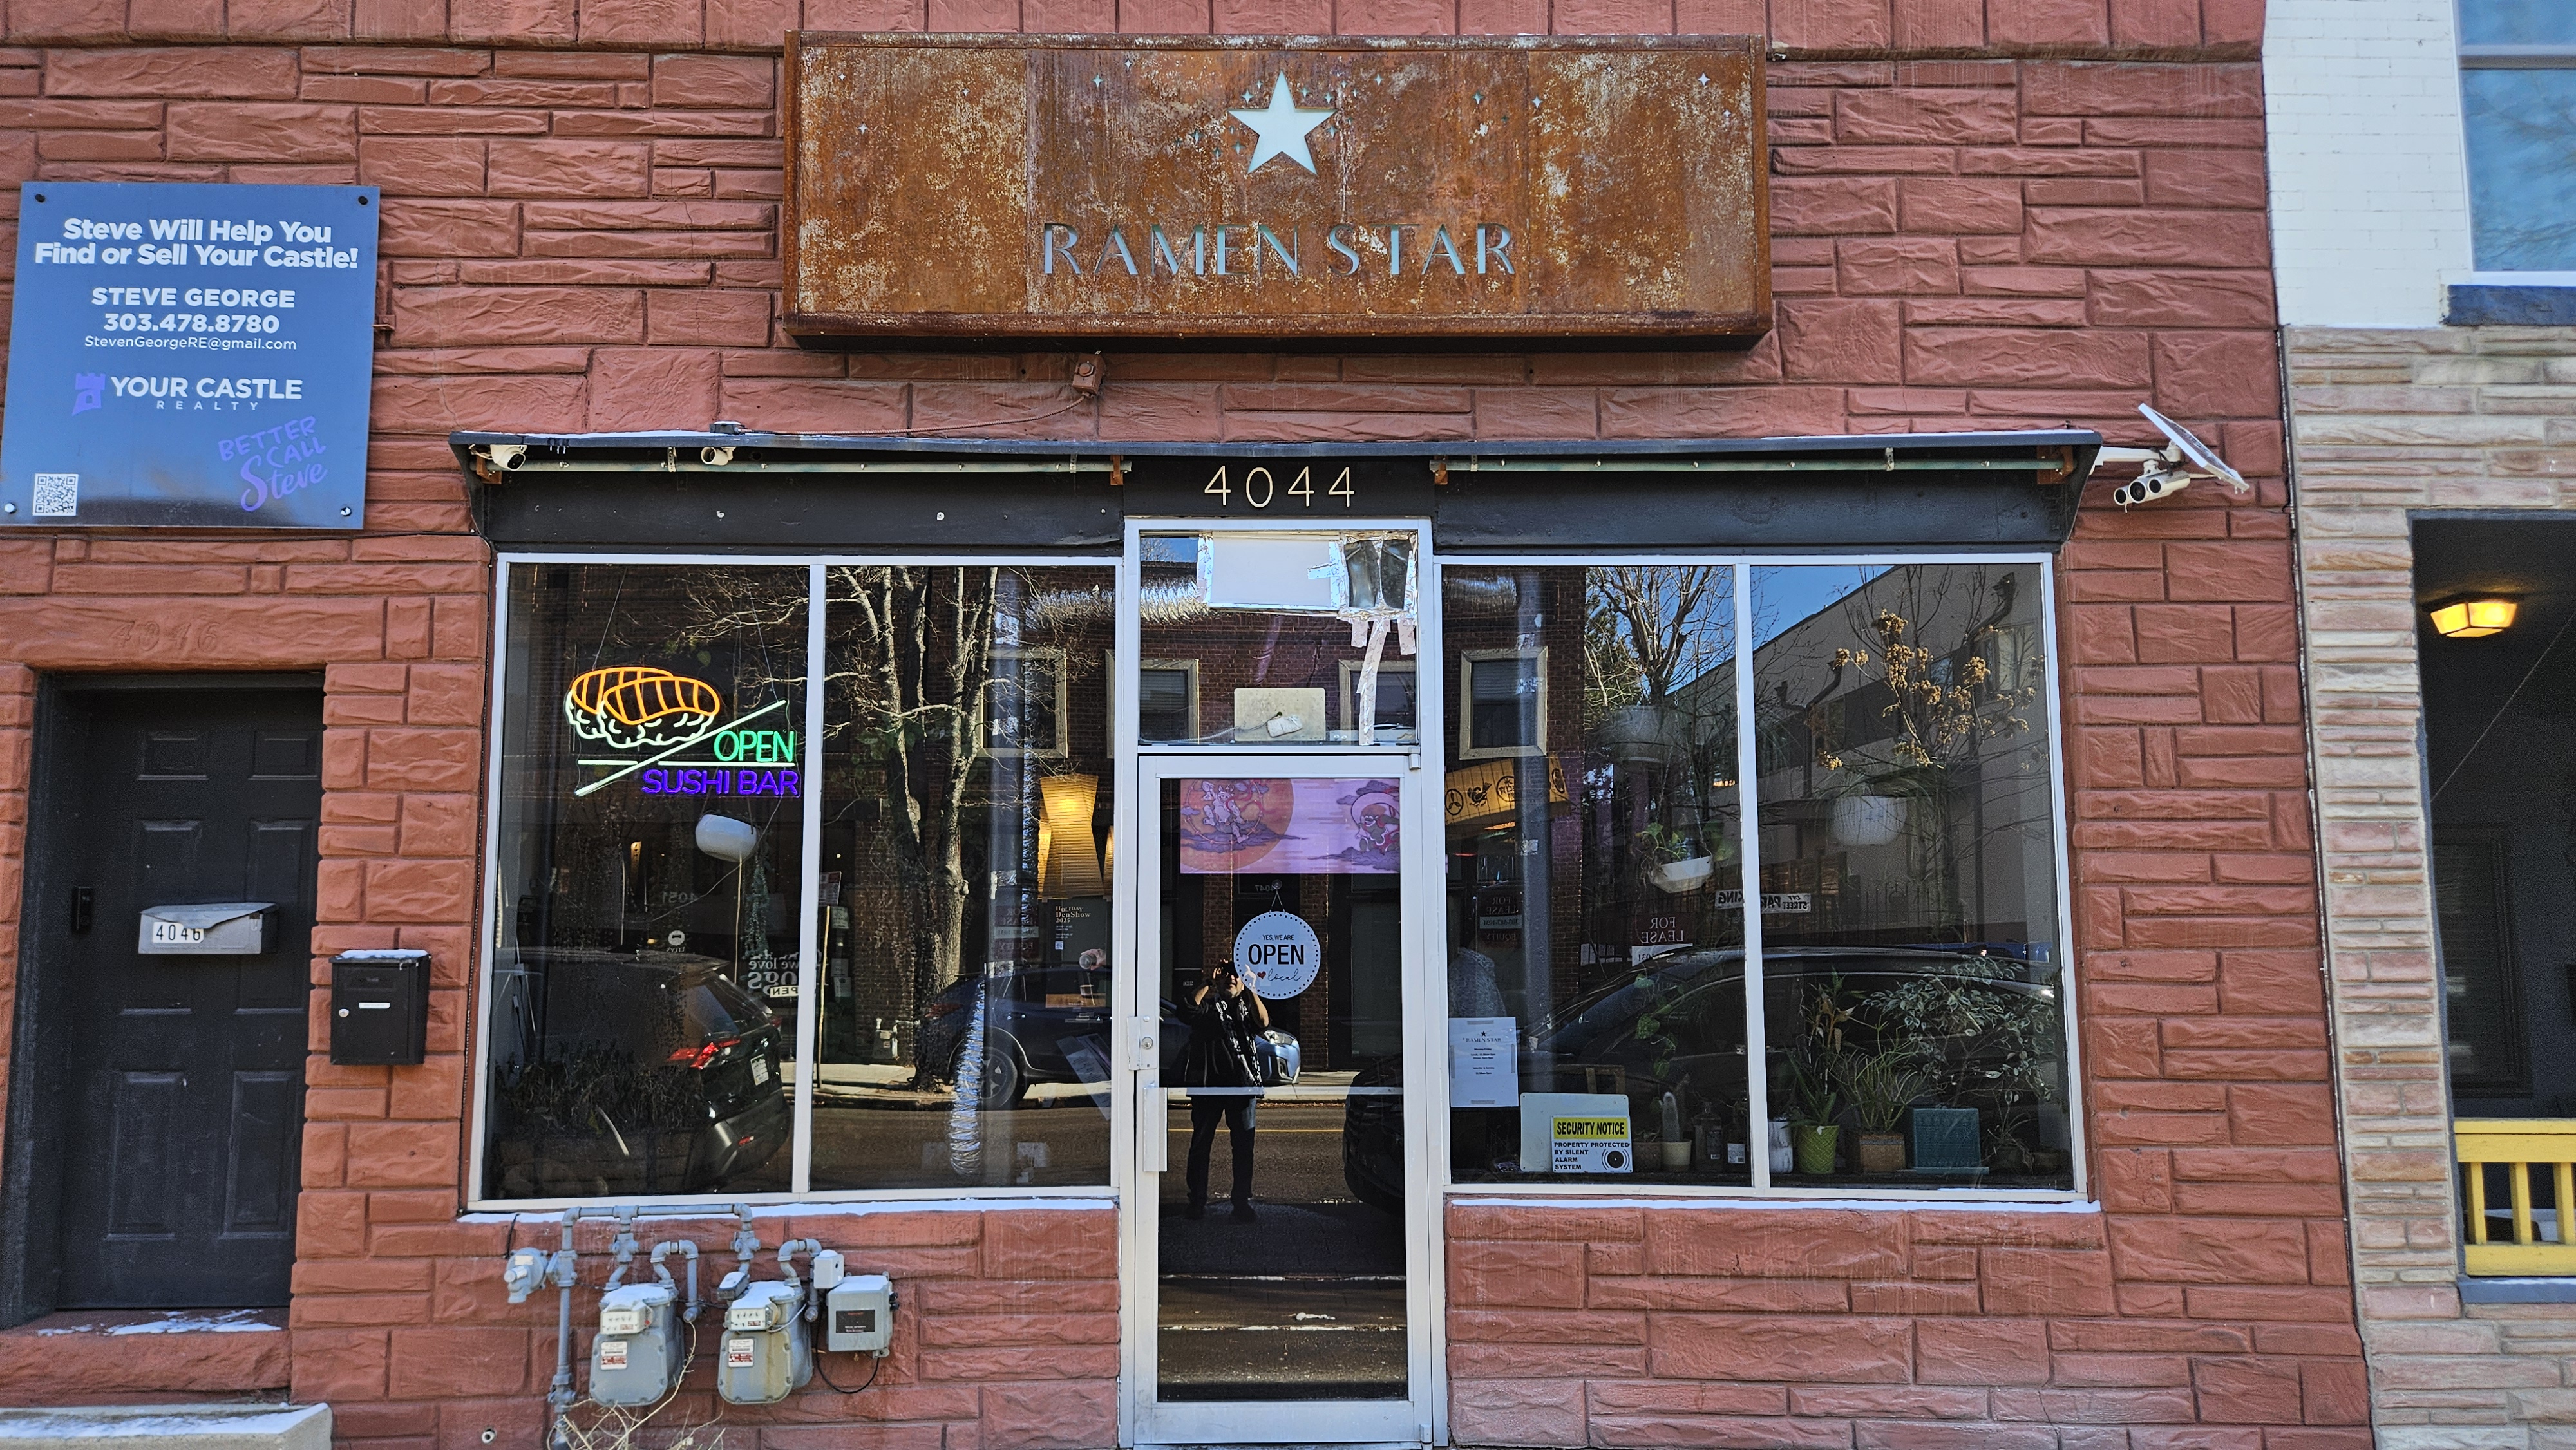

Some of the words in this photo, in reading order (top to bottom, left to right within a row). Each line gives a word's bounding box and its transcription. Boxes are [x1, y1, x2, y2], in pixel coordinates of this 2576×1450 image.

[64, 218, 142, 240] Steve
[149, 219, 202, 241] Will
[210, 220, 274, 245] Help
[280, 221, 331, 242] You
[35, 242, 99, 264] Find
[102, 248, 132, 265] or
[137, 243, 187, 265] Sell
[196, 245, 258, 267] Your
[263, 245, 358, 268] Castle!
[1043, 223, 1300, 276] RAMEN
[1329, 223, 1515, 276] STAR
[91, 288, 176, 306] STEVE
[185, 288, 295, 308] GEORGE
[104, 314, 280, 333] 303.478.8780
[84, 335, 297, 350] StevenGeorgeRE@gmail.com
[111, 376, 187, 397] YOUR
[196, 378, 303, 400] CASTLE
[156, 400, 260, 411] REALTY
[218, 415, 317, 461] BETTER
[266, 437, 327, 468] CALL
[241, 455, 328, 513] Steve
[1204, 465, 1356, 508] 4044
[714, 730, 795, 762] OPEN
[641, 769, 730, 796] SUSHI
[737, 770, 800, 796] BAR
[156, 924, 200, 941] 4046
[1248, 944, 1305, 965] OPEN
[1267, 968, 1302, 983] local
[1557, 1122, 1595, 1135] SECURITY
[1596, 1122, 1625, 1135] NOTICE
